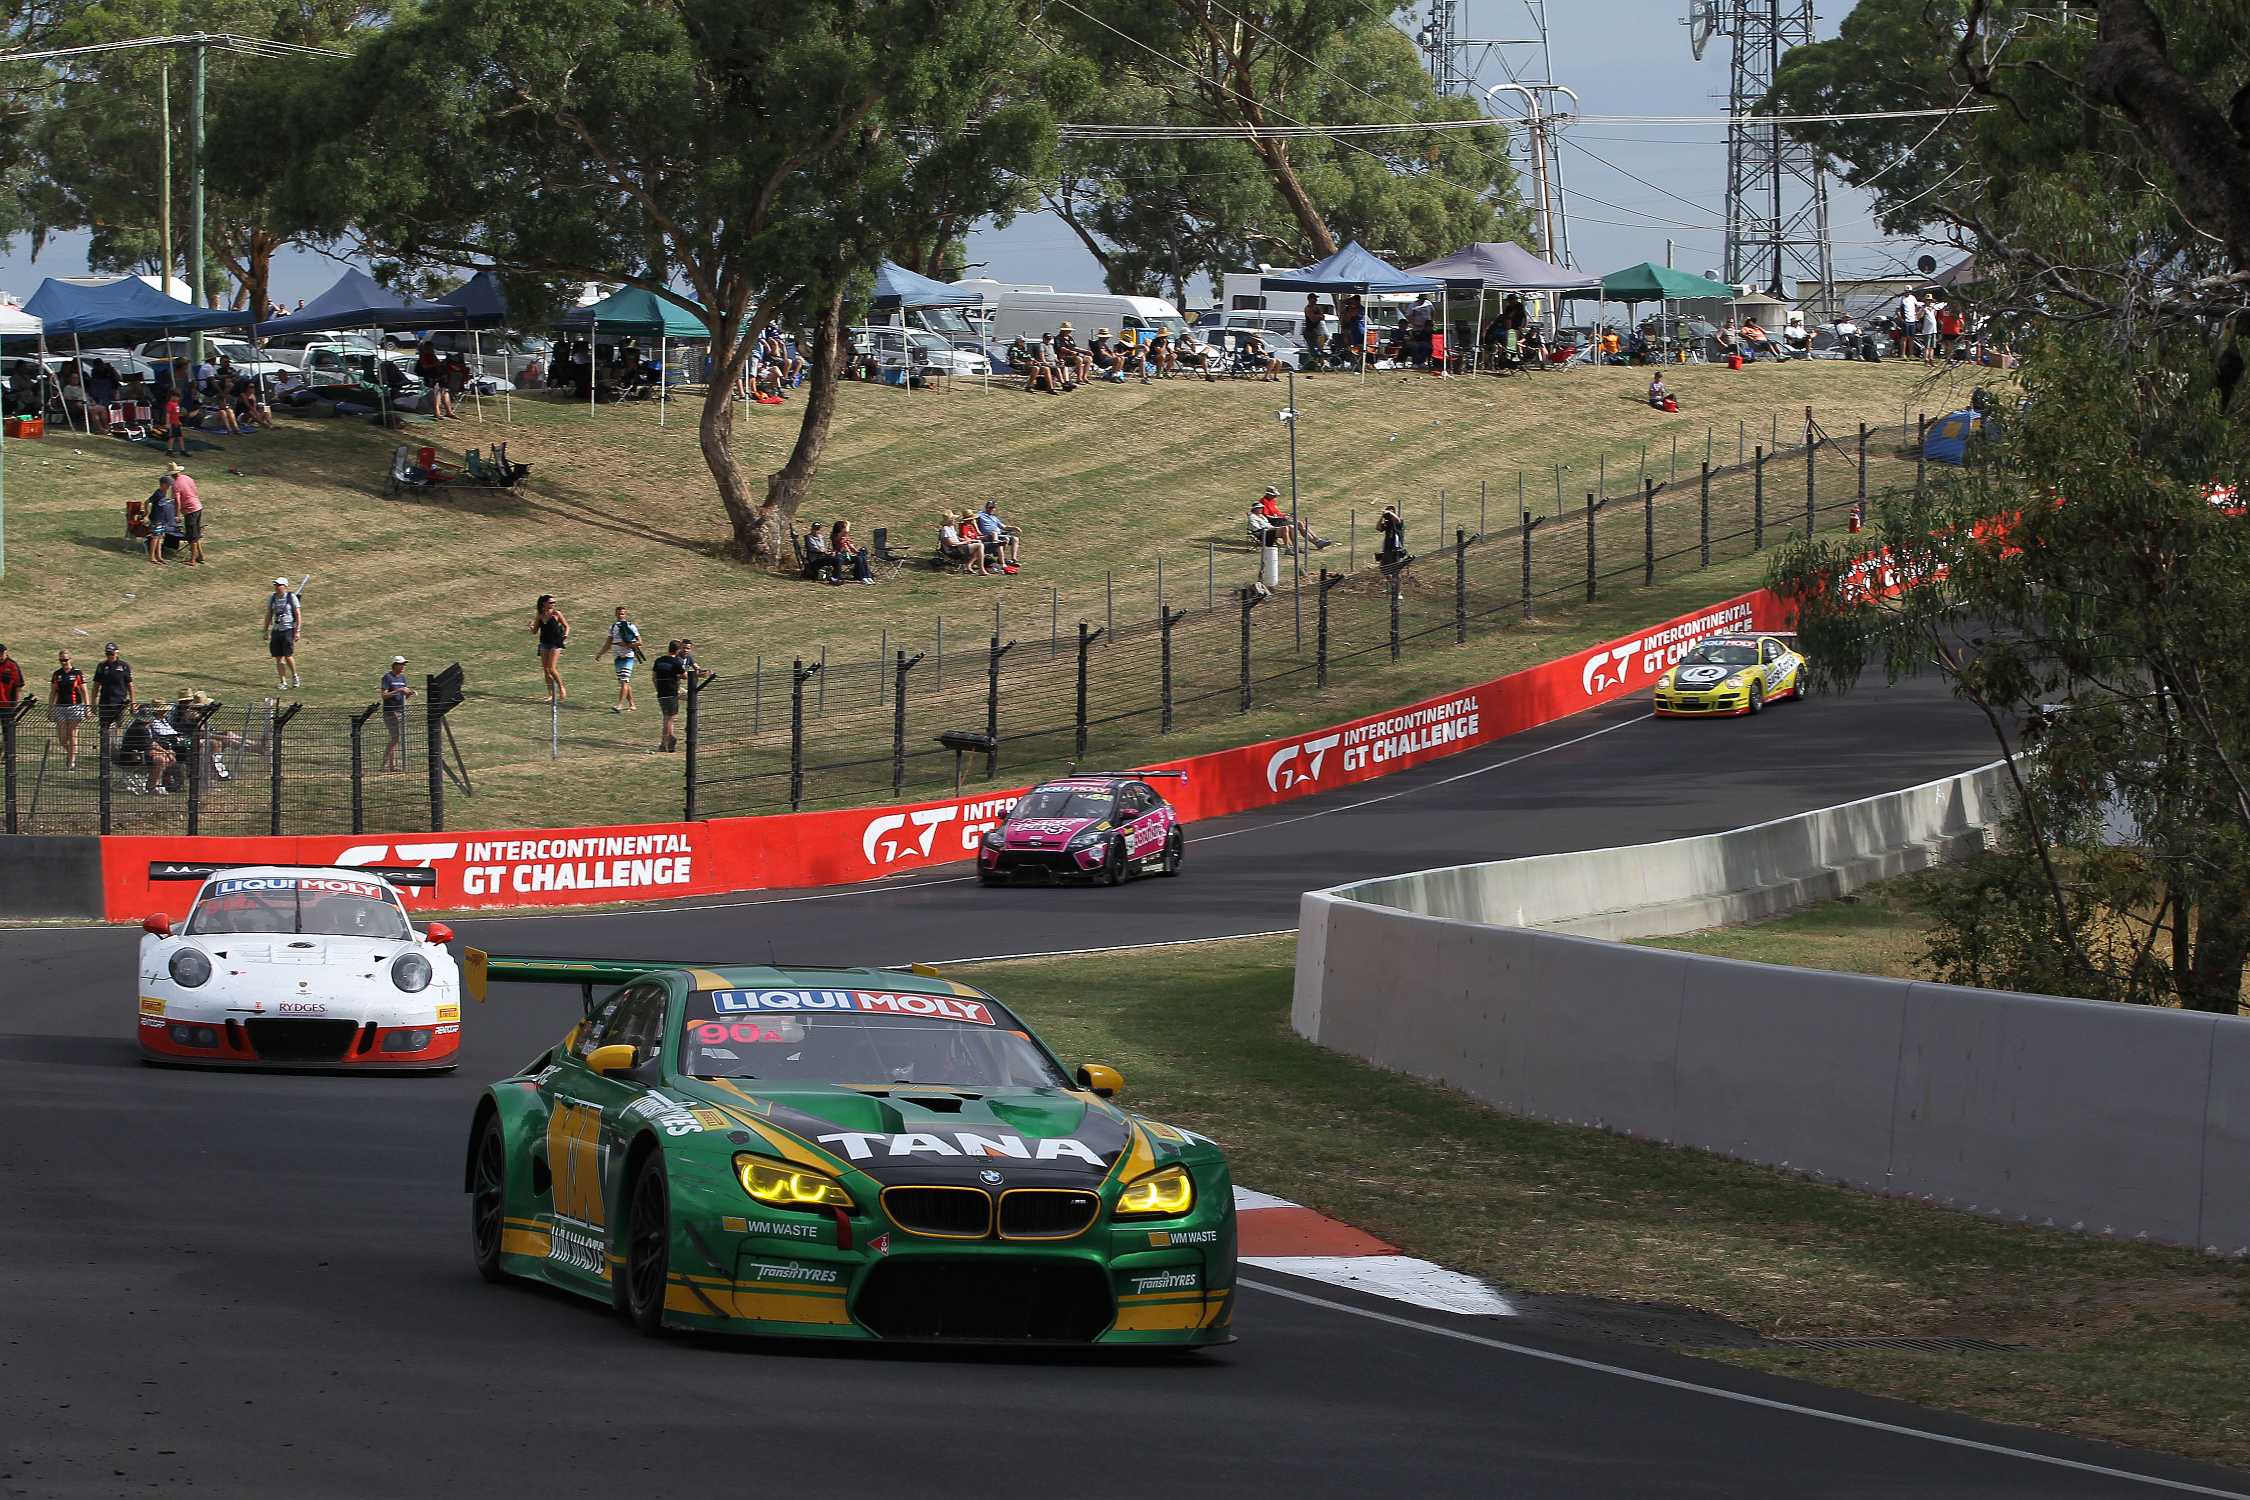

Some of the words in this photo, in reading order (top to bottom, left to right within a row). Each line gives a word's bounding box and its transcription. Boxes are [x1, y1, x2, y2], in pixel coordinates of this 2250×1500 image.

[1644, 602, 1753, 651] INTERCONTINENTAL
[1643, 649, 1665, 674] GT
[1343, 696, 1479, 746] INTERCONTINENTAL
[1343, 746, 1369, 771] GT
[1373, 714, 1479, 763] CHALLENGE
[1266, 734, 1341, 792] GT
[465, 834, 692, 862] INTERCONTINENTAL
[863, 806, 959, 864] GT
[219, 879, 296, 893] LIQUI
[301, 879, 379, 897] MOLY
[463, 865, 510, 895] GT
[512, 857, 692, 893] CHALLENGE
[280, 1003, 326, 1012] RYDGES
[721, 991, 854, 1010] LIQUI
[858, 993, 984, 1019] MOLY
[816, 1132, 1108, 1167] TANA
[748, 1220, 770, 1233] WM
[773, 1223, 818, 1238] WASTE
[1170, 1232, 1189, 1244] WM
[1189, 1231, 1217, 1243] WASTE
